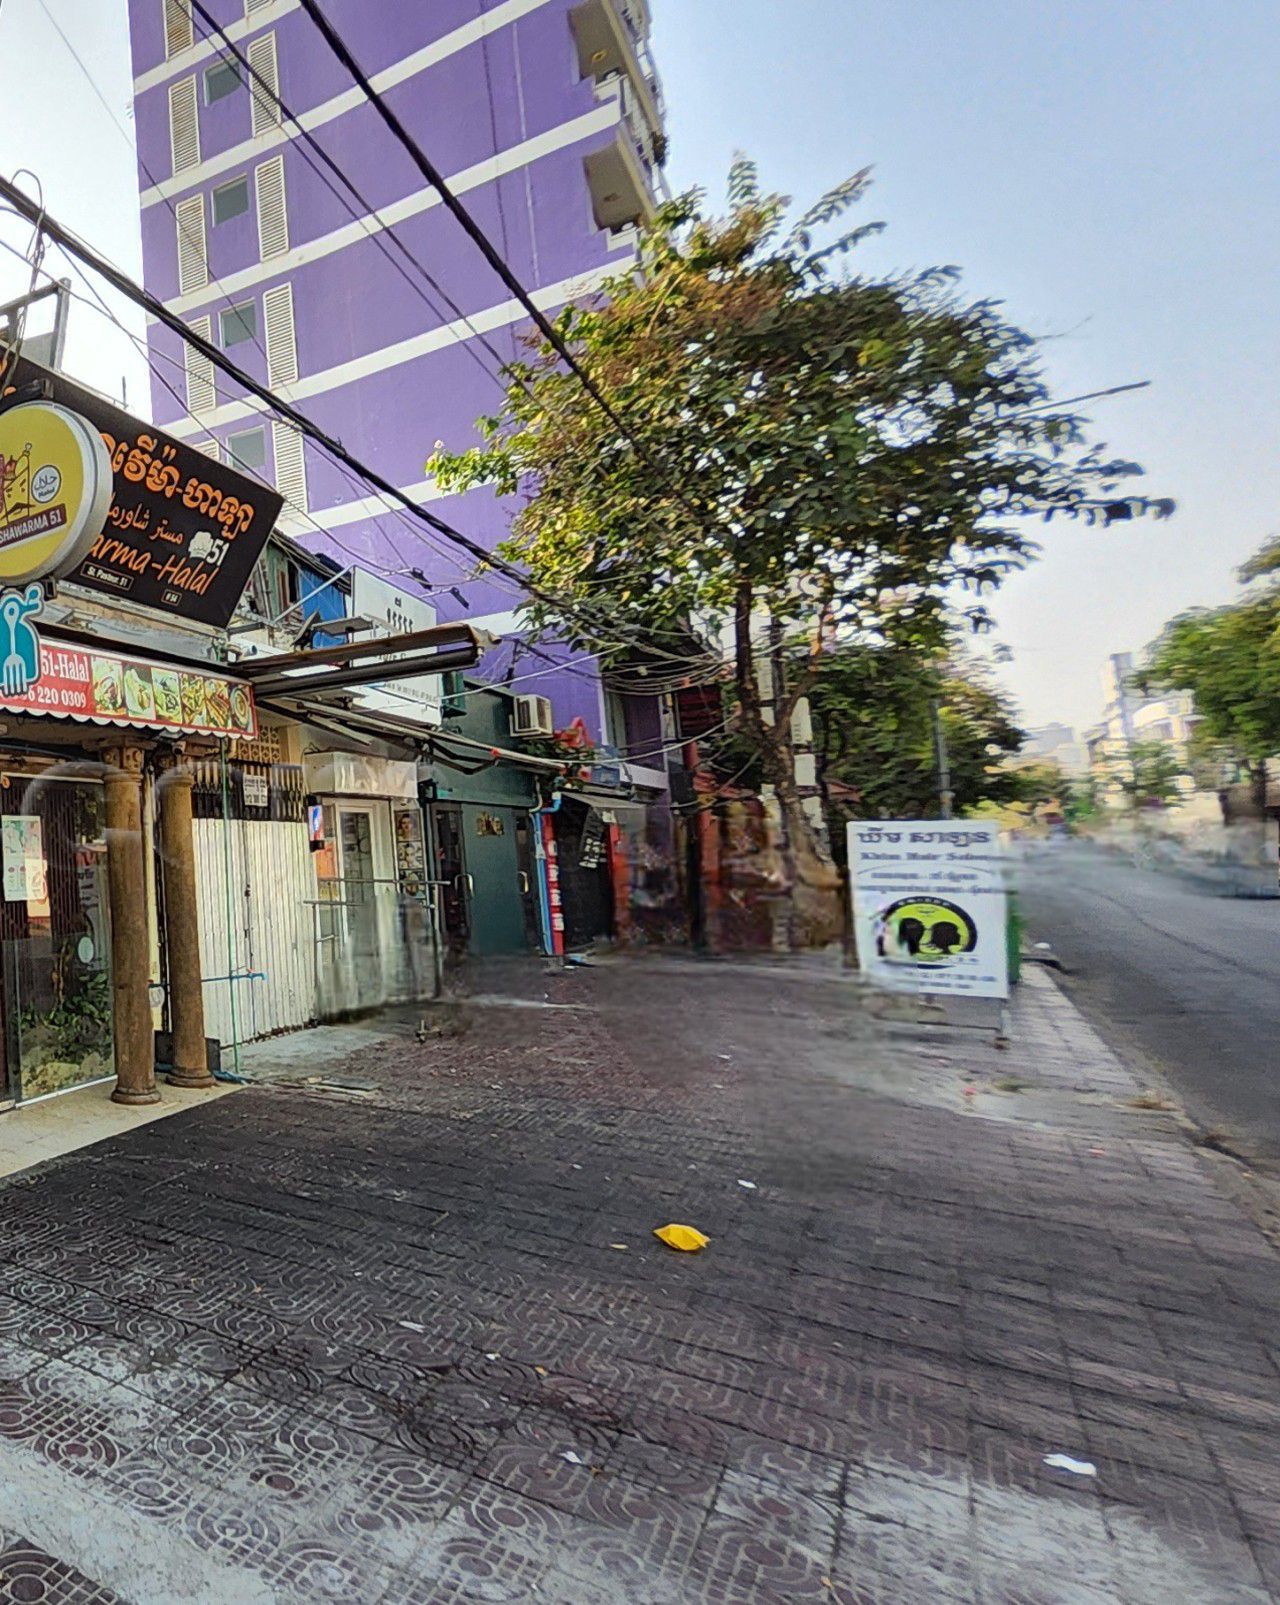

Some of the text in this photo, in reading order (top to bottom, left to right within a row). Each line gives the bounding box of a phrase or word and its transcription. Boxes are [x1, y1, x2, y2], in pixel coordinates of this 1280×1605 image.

[49, 509, 62, 525] 51
[206, 538, 230, 566] 51
[37, 686, 59, 704] 220
[61, 689, 86, 709] 0309
